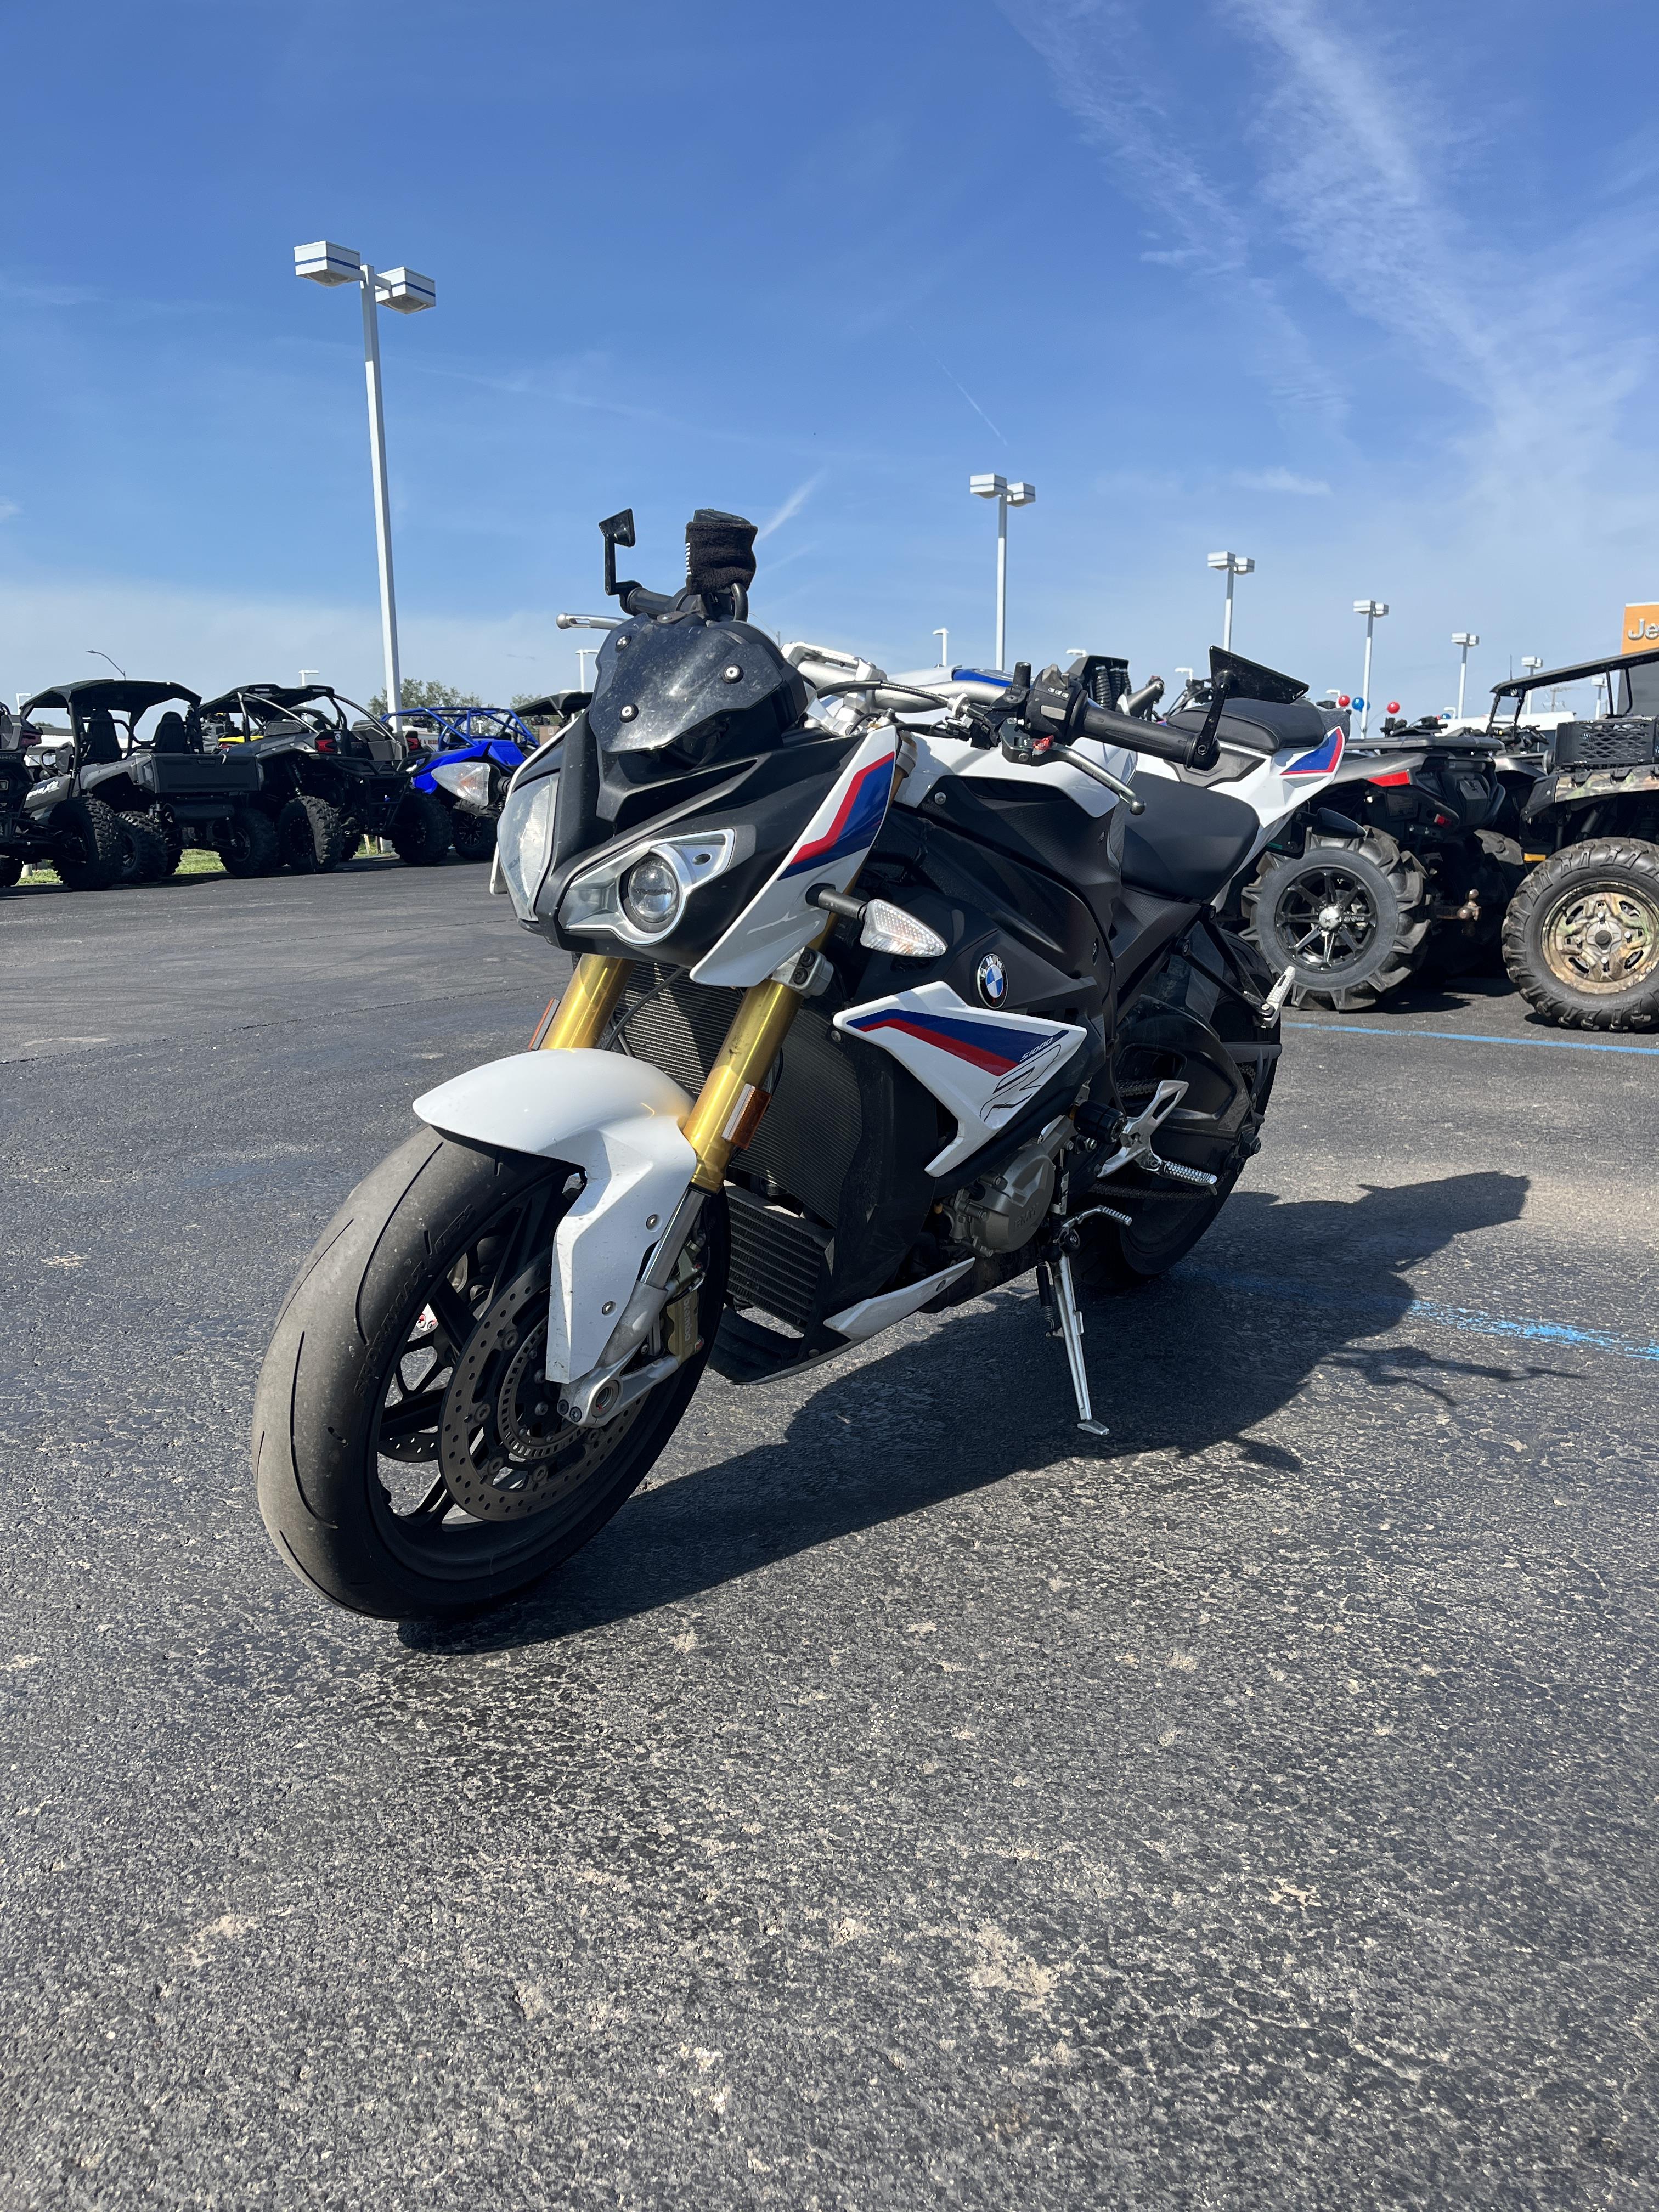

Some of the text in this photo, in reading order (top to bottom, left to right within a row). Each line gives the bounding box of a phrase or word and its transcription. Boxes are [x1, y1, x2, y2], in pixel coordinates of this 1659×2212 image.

[1627, 618, 1659, 640] Je
[1019, 1037, 1053, 1063] S1000
[353, 1260, 428, 1397] SPORTMAX
[684, 1295, 692, 1342] brembo
